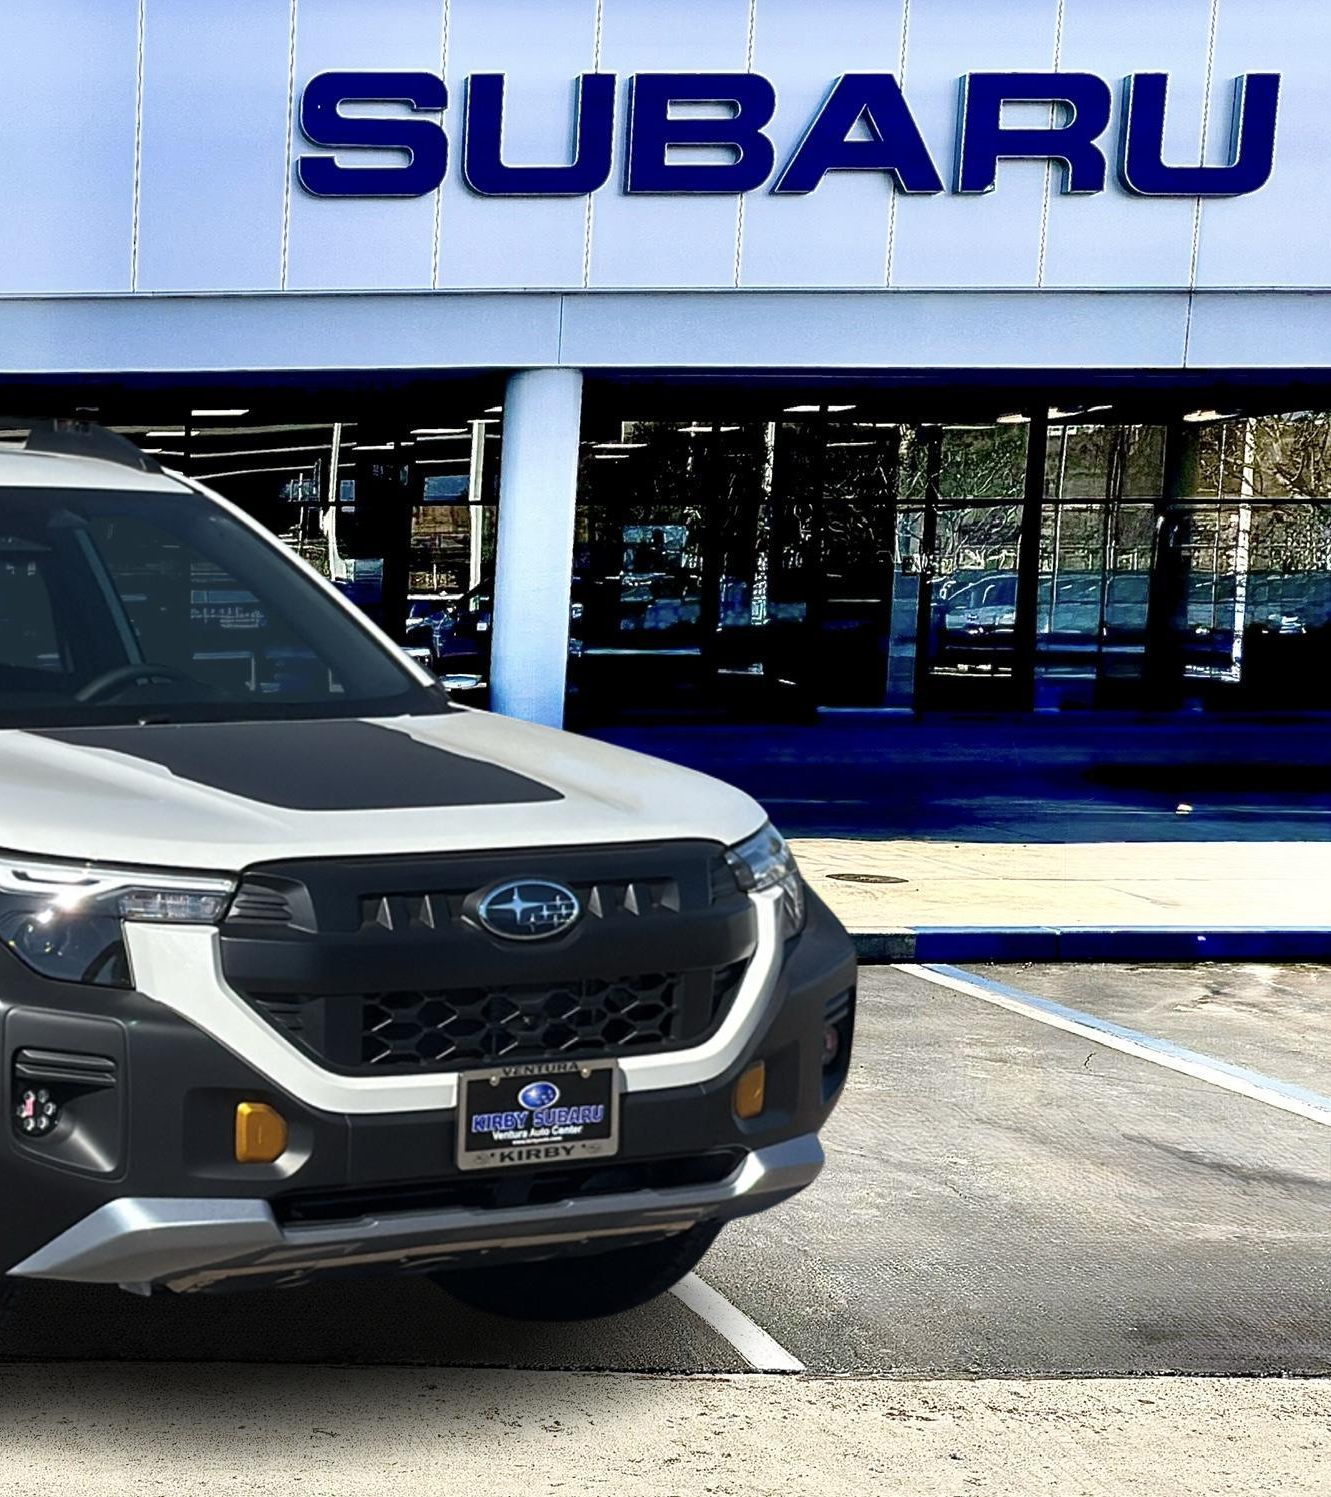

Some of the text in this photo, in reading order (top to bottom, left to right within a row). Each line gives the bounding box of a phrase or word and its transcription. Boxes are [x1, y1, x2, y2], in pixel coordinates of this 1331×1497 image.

[297, 70, 1281, 197] SUBARU
[502, 1061, 579, 1077] VENTURA
[471, 1104, 604, 1133] KIRBY SUBARU
[492, 1125, 583, 1140] Ventura Auto Center
[499, 1145, 575, 1163] KIRBY
